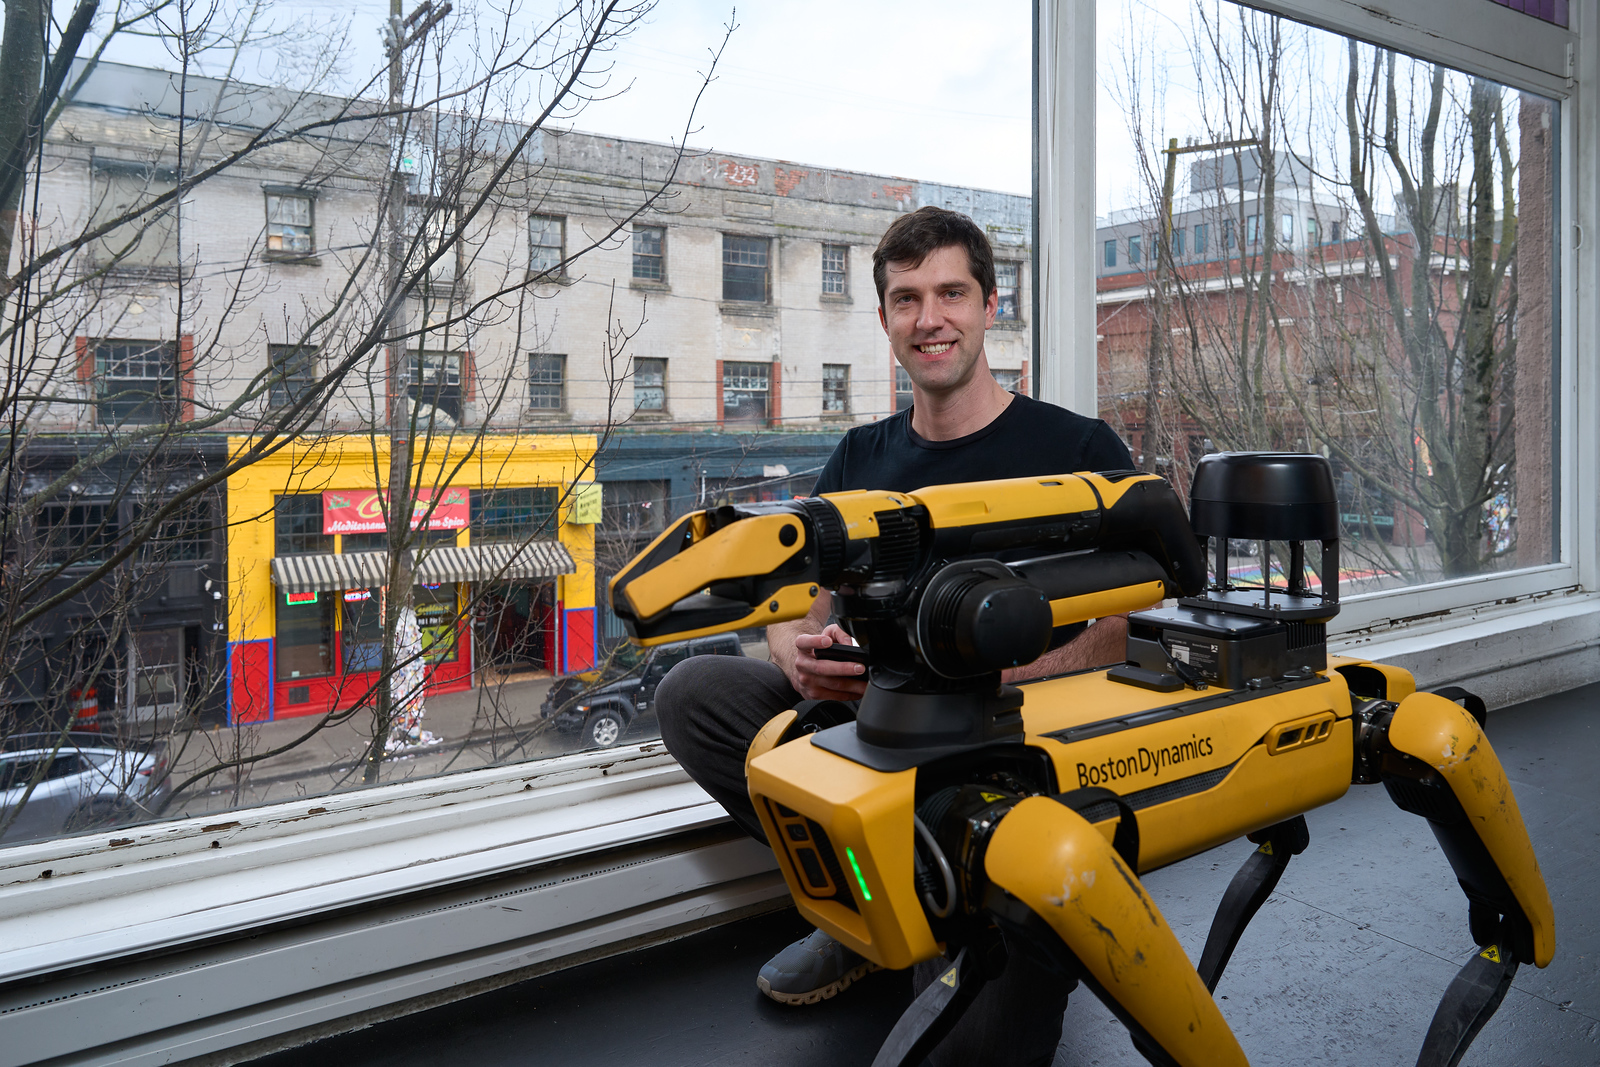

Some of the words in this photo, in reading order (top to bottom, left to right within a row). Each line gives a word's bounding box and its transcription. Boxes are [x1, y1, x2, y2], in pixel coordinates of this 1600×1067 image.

[327, 520, 387, 533] Mediterrane
[442, 517, 465, 529] Spice
[1076, 733, 1213, 788] BostonDynamics
